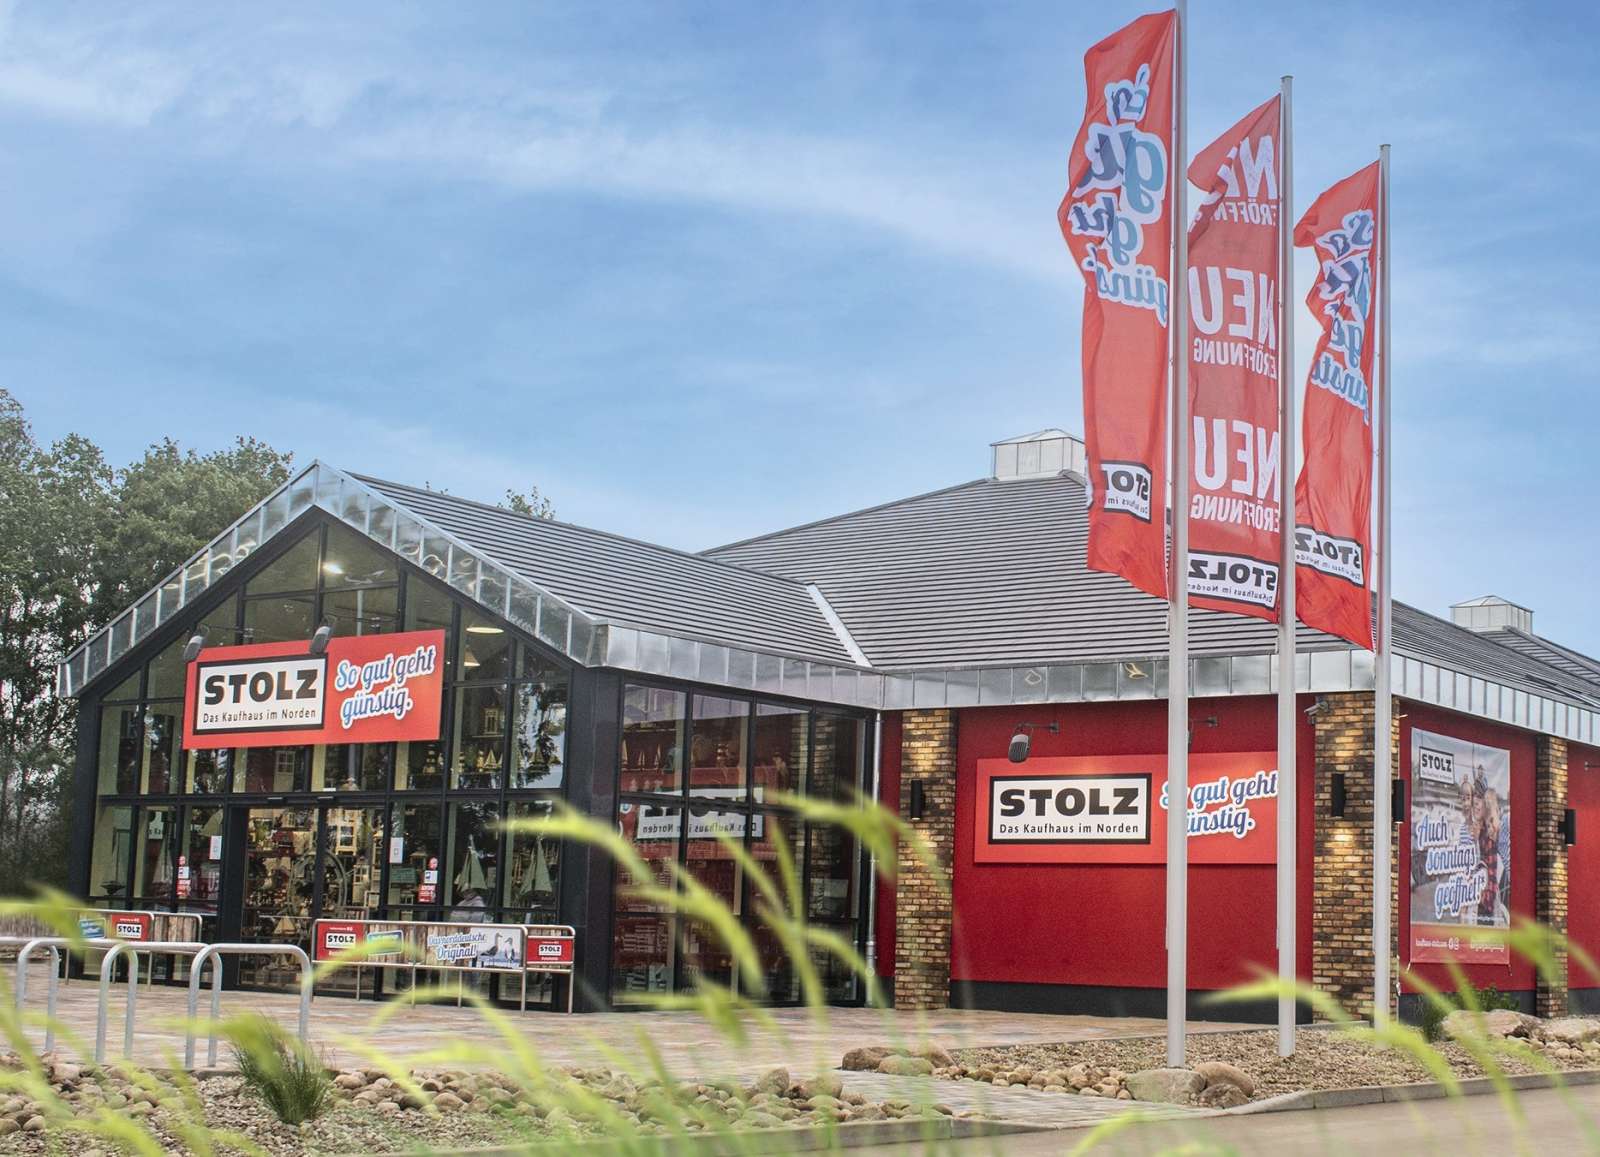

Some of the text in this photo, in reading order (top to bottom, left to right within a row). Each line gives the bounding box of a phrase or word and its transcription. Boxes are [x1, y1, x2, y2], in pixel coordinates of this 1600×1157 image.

[336, 648, 434, 690] So gut geht
[204, 669, 318, 706] STOLZ
[203, 708, 316, 723] Das Kaufhaus im Norden
[342, 687, 411, 726] günstig.
[1422, 753, 1452, 772] STOLZ
[999, 787, 1139, 817] STOLZ
[1193, 779, 1227, 810] gut
[1232, 773, 1278, 806] geht
[999, 822, 1139, 833] Das Kaufhaus im Norden
[1187, 807, 1253, 835] ünstig.
[1418, 815, 1448, 847] Auch
[1427, 847, 1476, 873] sonntags
[118, 925, 140, 933] STOLZ
[327, 935, 354, 943] STOLZ
[437, 944, 477, 961] Original!
